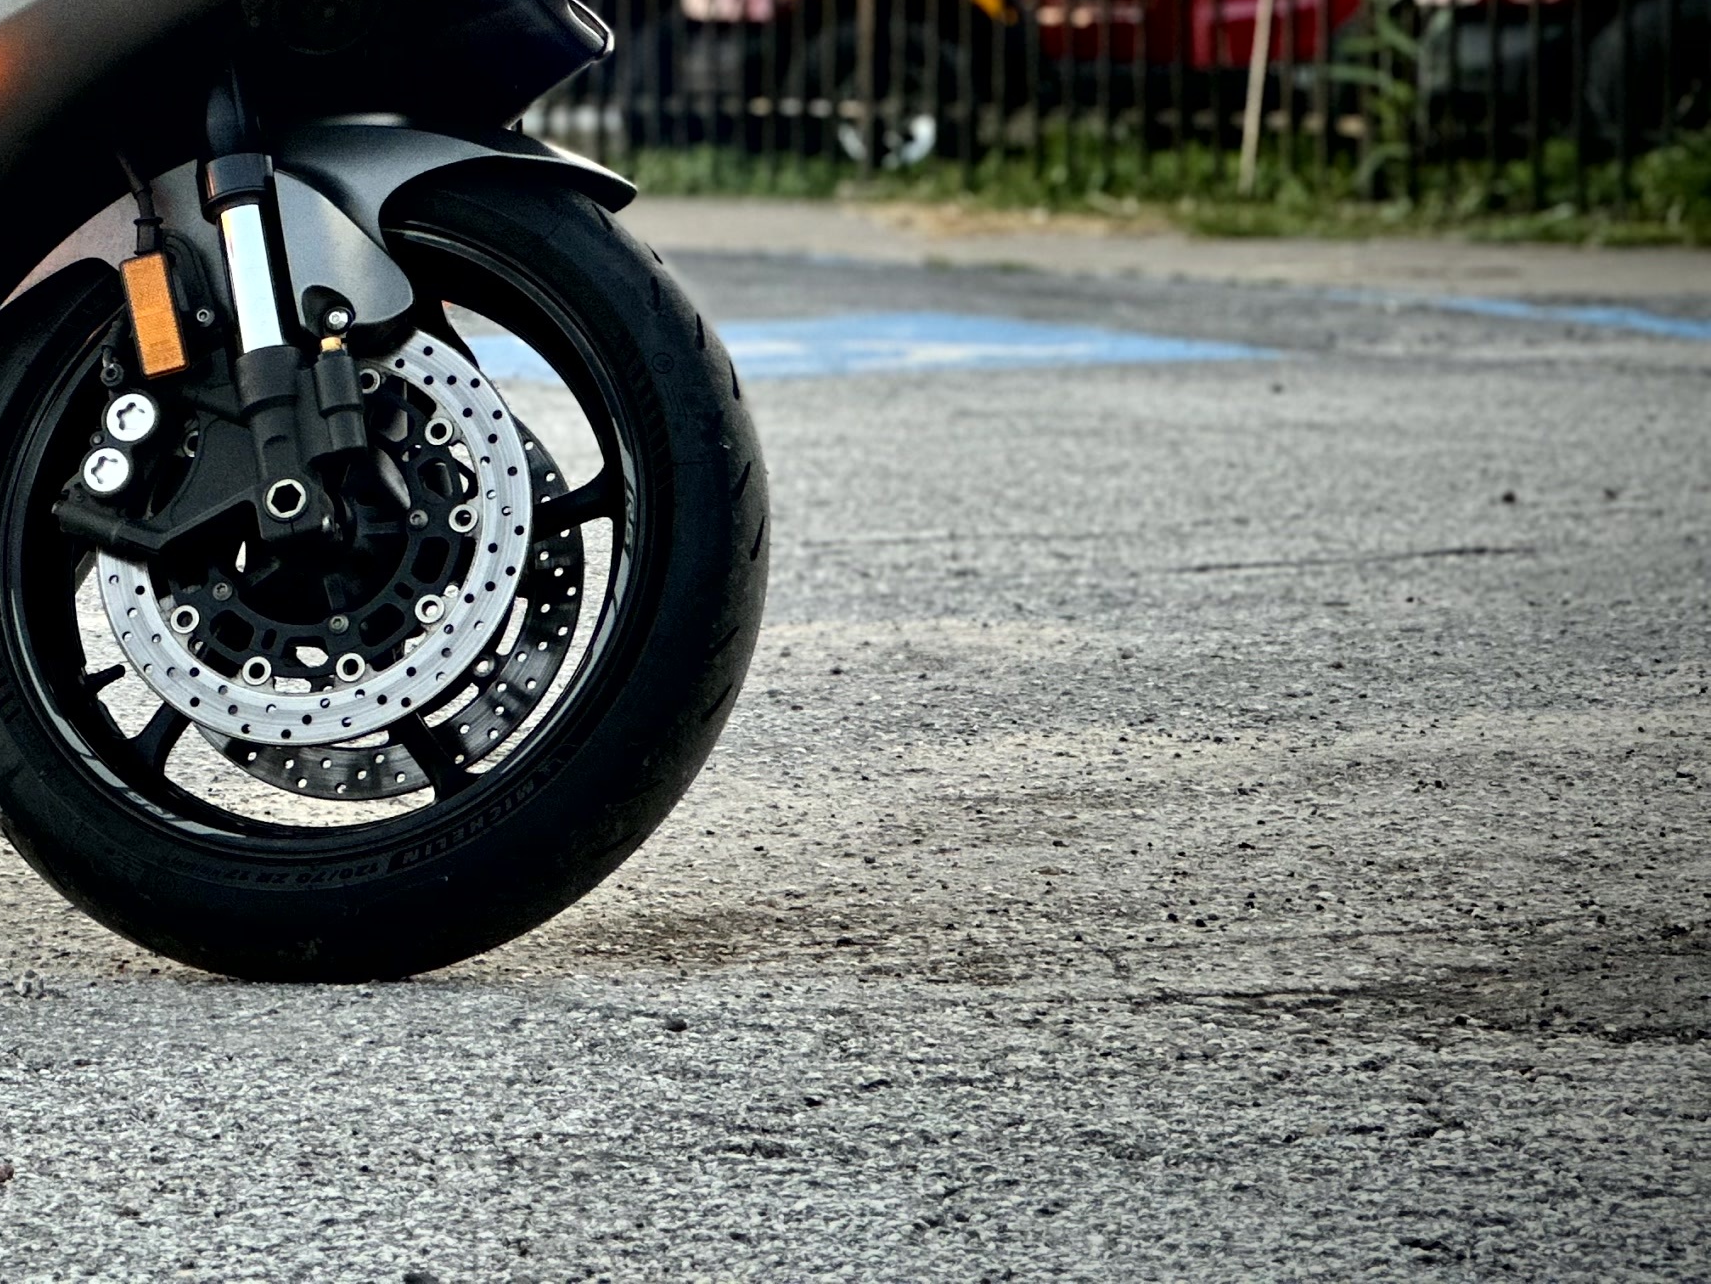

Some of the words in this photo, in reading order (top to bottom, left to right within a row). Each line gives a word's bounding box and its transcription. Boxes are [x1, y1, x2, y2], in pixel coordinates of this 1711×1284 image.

[402, 778, 535, 865] MICHELIN
[255, 872, 290, 884] ZR
[296, 863, 378, 883] 120/70
